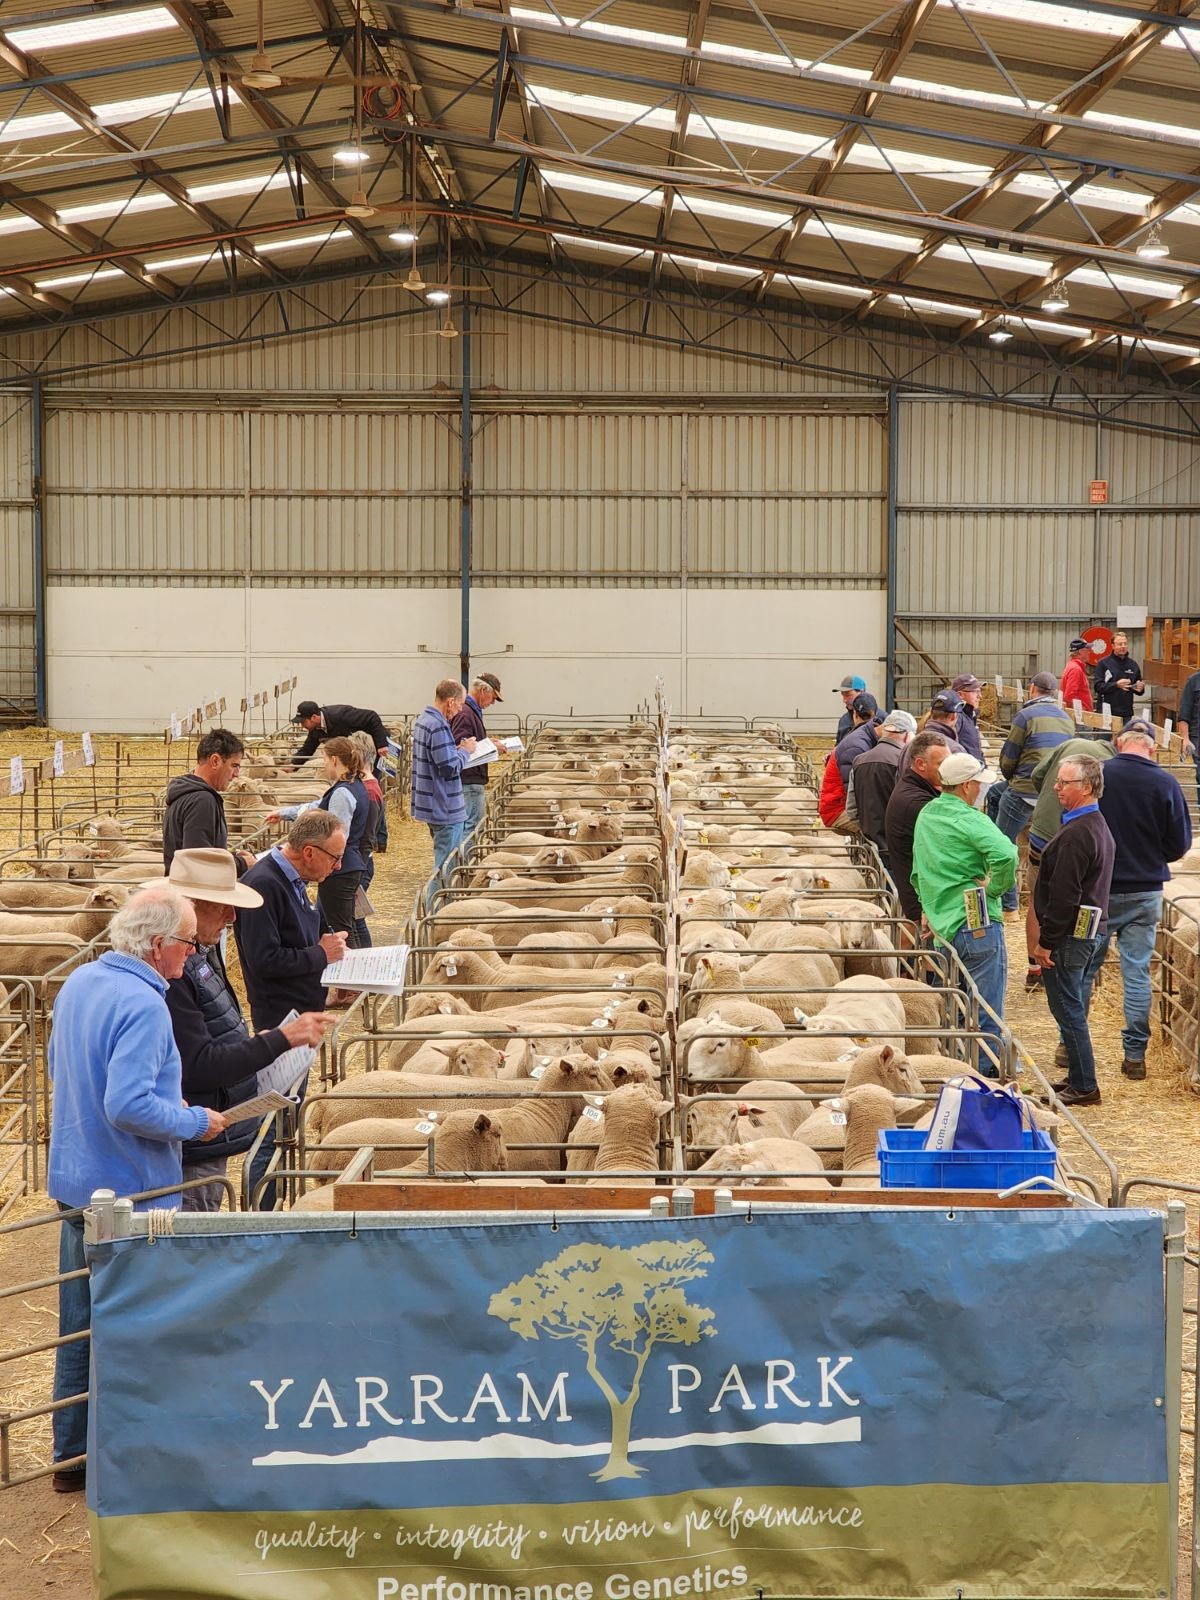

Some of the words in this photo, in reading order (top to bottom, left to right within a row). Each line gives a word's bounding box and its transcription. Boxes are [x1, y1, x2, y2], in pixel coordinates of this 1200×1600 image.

[586, 1108, 600, 1119] 108
[831, 1113, 844, 1124] 105
[249, 1371, 573, 1430] YARRAM
[667, 1355, 860, 1414] PARK
[254, 1521, 364, 1560] quality
[396, 1519, 531, 1560] integrity
[561, 1518, 655, 1546] vision
[684, 1496, 863, 1549] performance
[377, 1576, 593, 1600] Performance
[605, 1564, 748, 1600] Genetics
